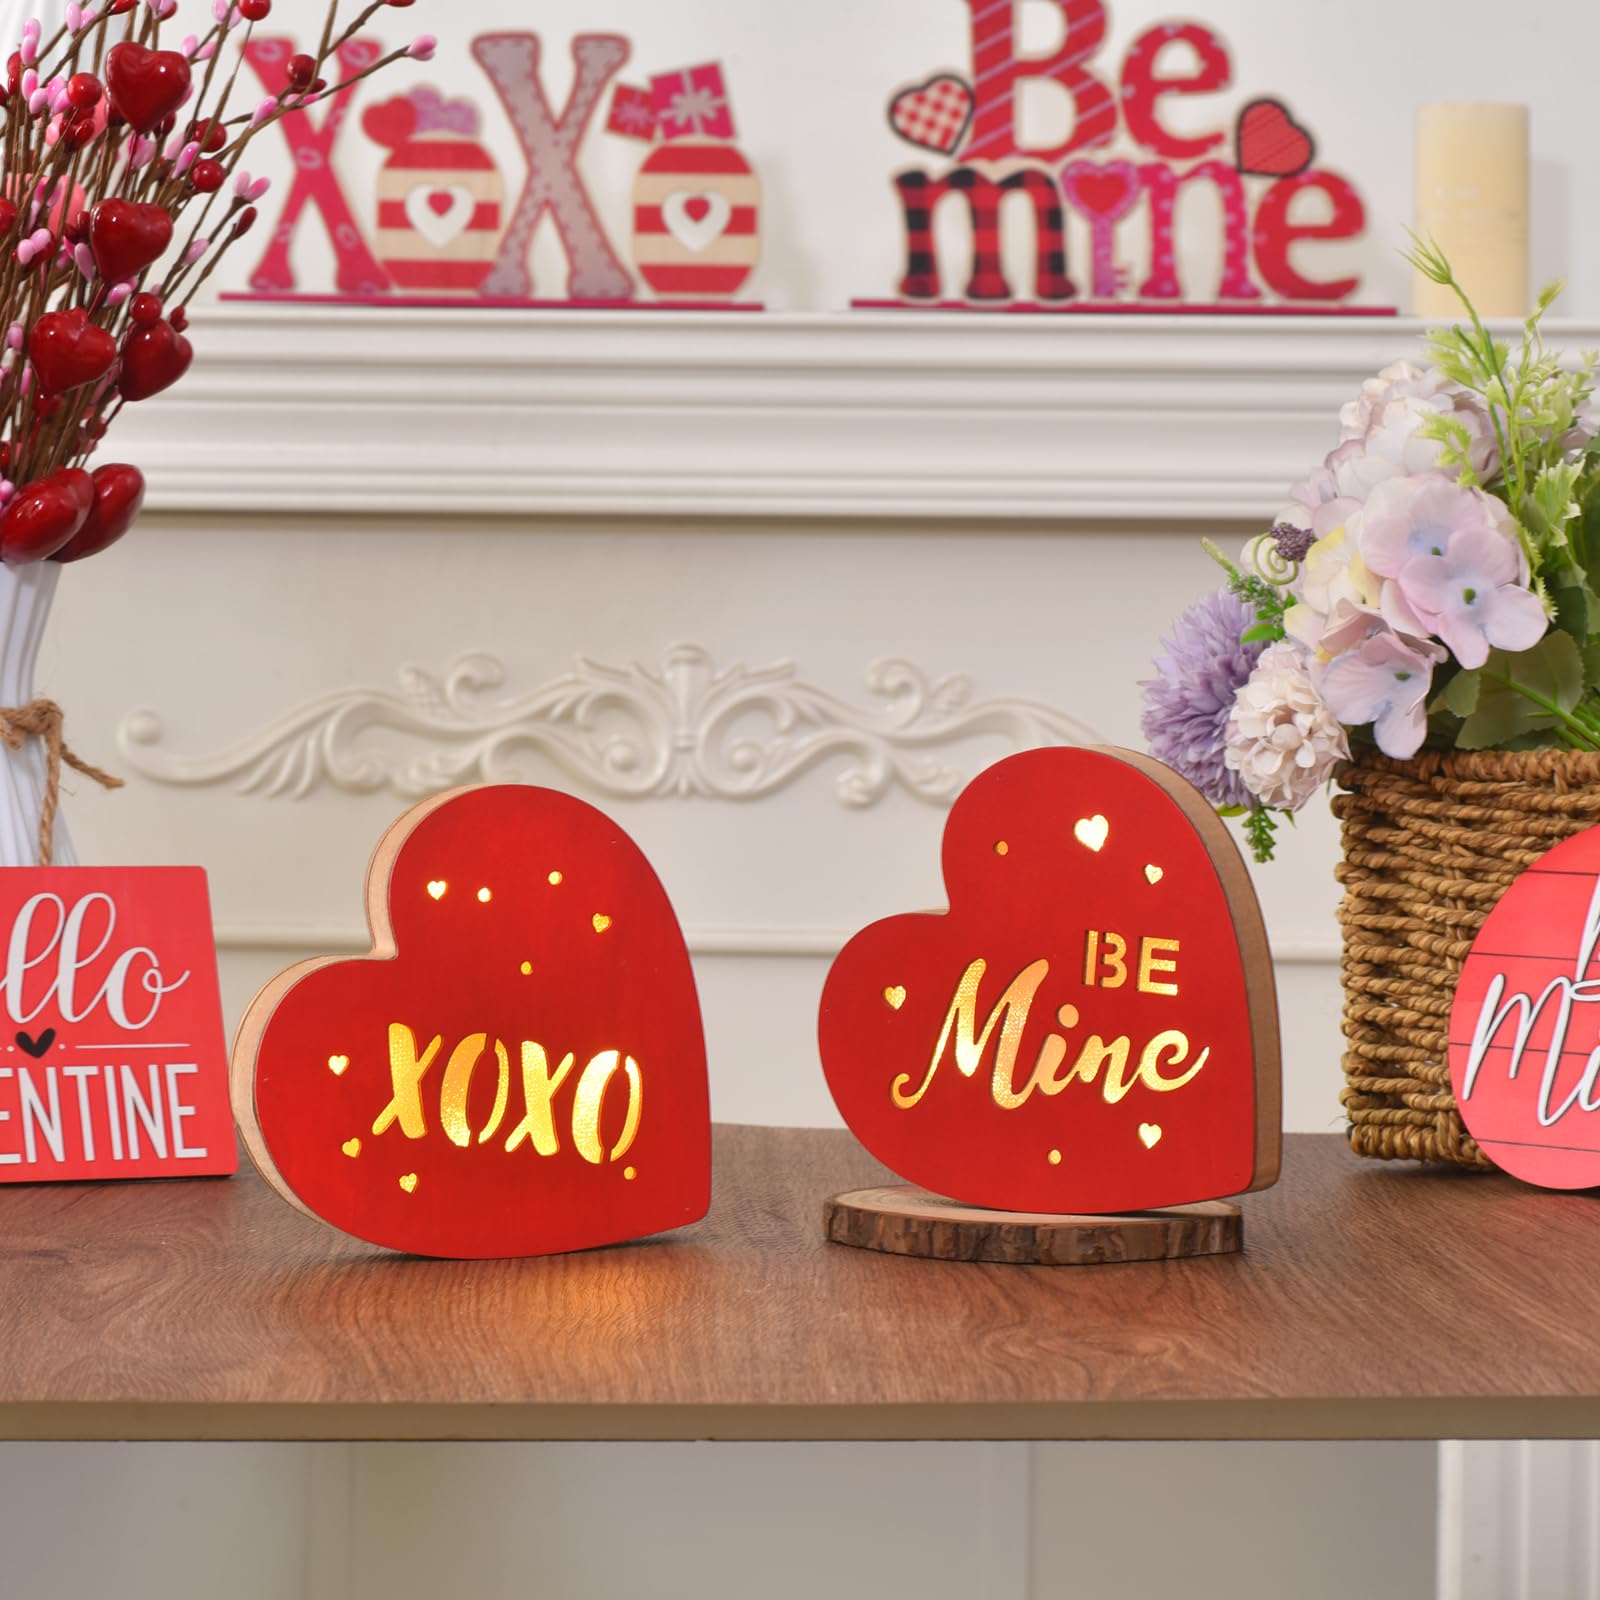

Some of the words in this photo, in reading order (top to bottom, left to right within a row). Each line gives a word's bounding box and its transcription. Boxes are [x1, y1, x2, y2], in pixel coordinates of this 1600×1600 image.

[960, 0, 1233, 163] Be
[889, 957, 1210, 1110] Mine
[1082, 929, 1181, 996] BE
[371, 1022, 643, 1165] XOXO
